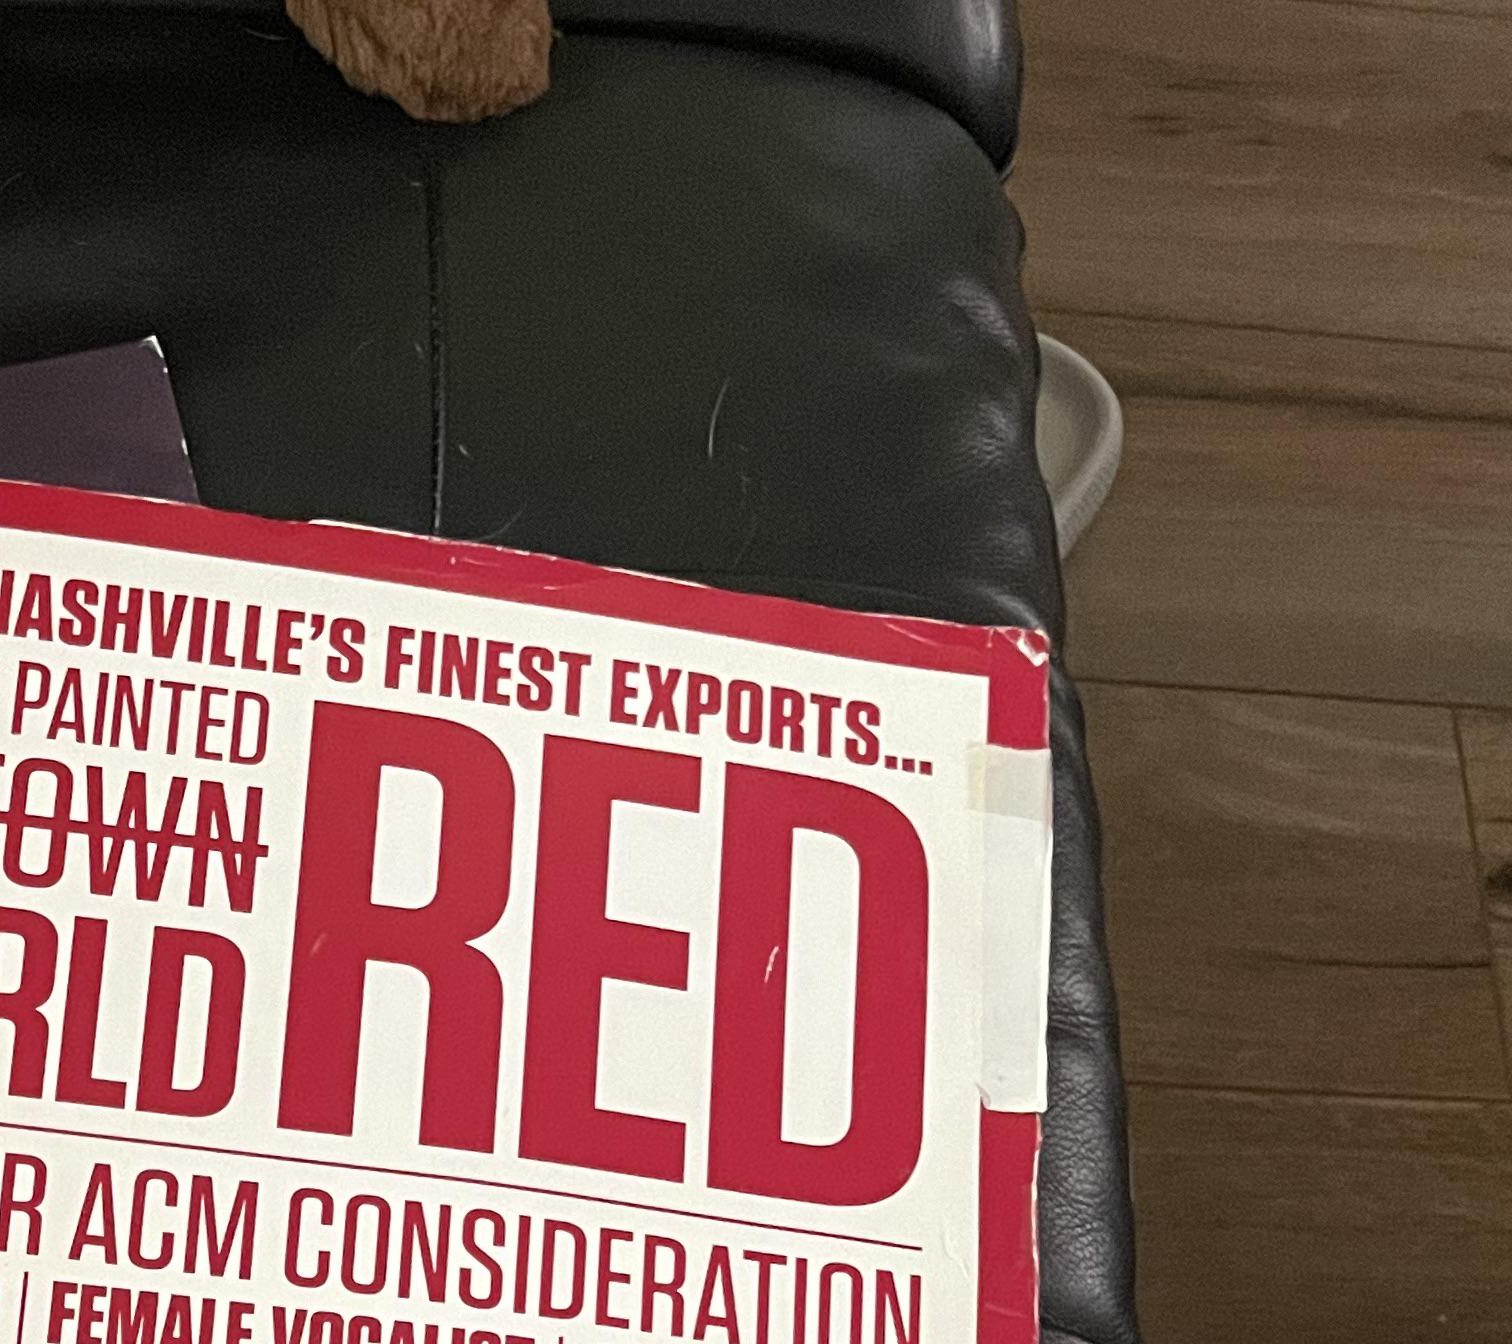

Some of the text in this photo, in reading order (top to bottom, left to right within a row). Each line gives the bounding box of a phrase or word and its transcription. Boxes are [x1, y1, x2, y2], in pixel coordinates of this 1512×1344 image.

[11, 661, 269, 764] PAINTED
[385, 626, 591, 716] FINEST
[610, 660, 930, 775] EXPORTS...
[277, 700, 928, 1206] RED
[69, 1163, 259, 1280] ACM
